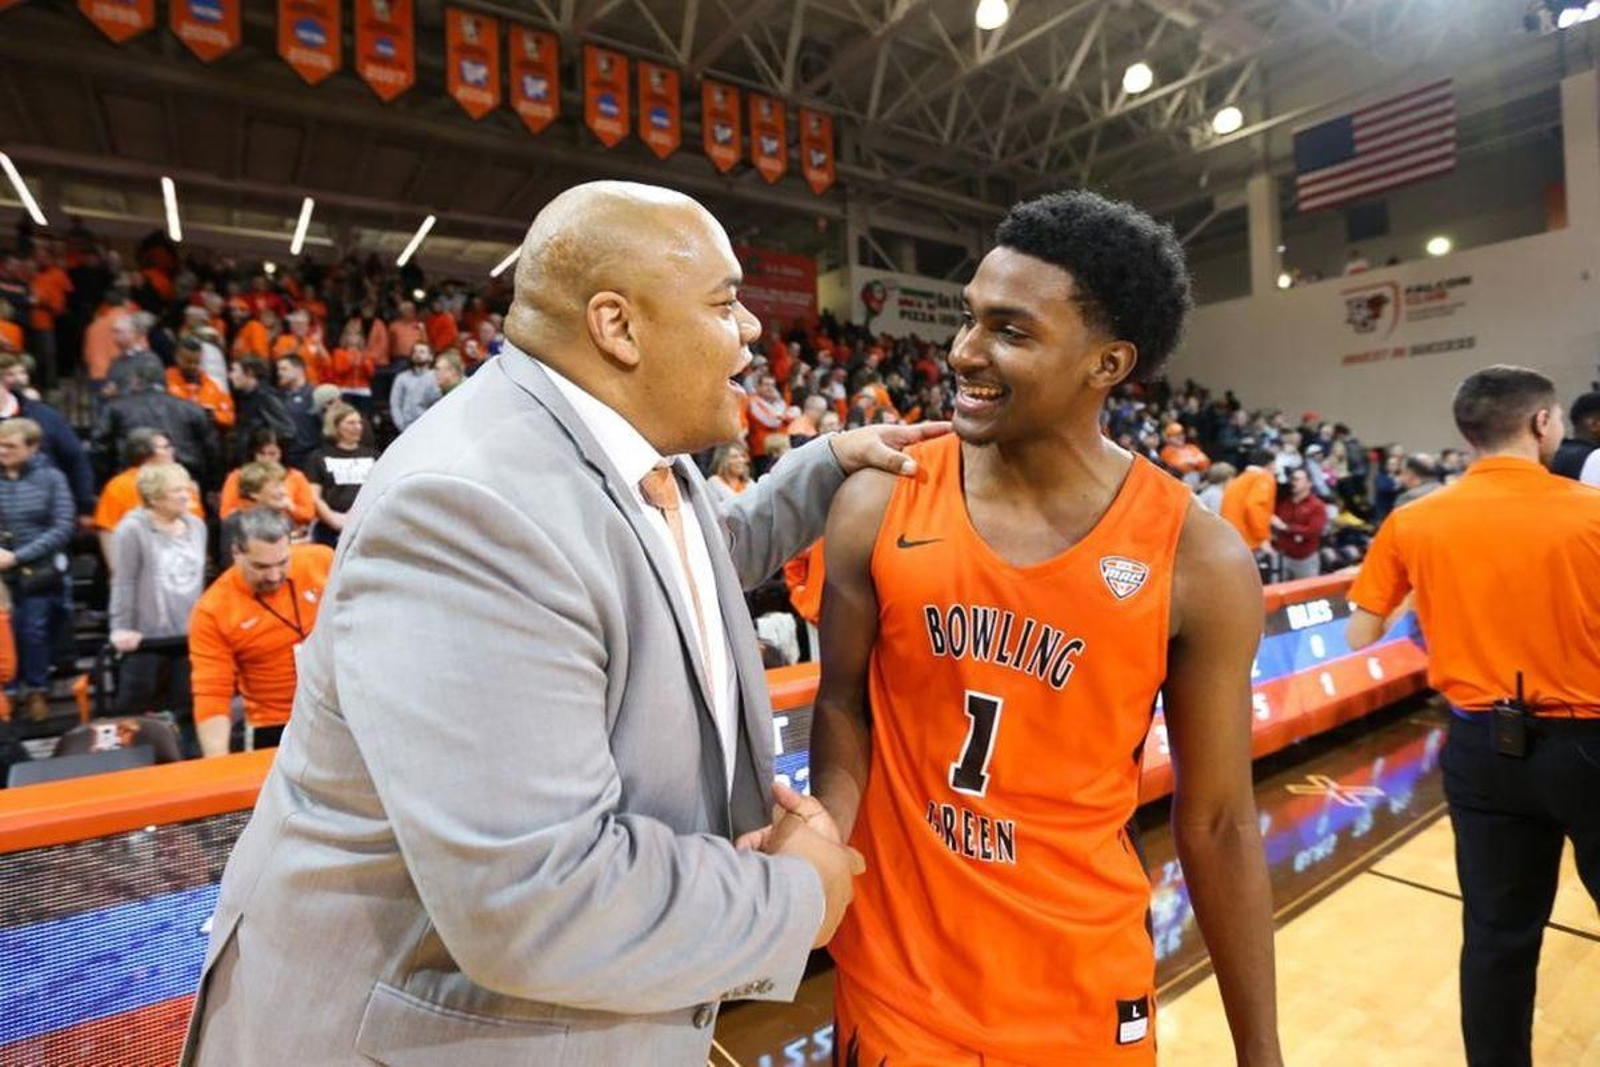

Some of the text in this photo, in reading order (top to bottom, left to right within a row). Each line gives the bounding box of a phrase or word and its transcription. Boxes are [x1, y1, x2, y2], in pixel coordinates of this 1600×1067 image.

[899, 309, 936, 324] PIZZA
[924, 604, 1085, 690] BOWLING
[949, 690, 1004, 798] 1
[1132, 1004, 1141, 1018] L
